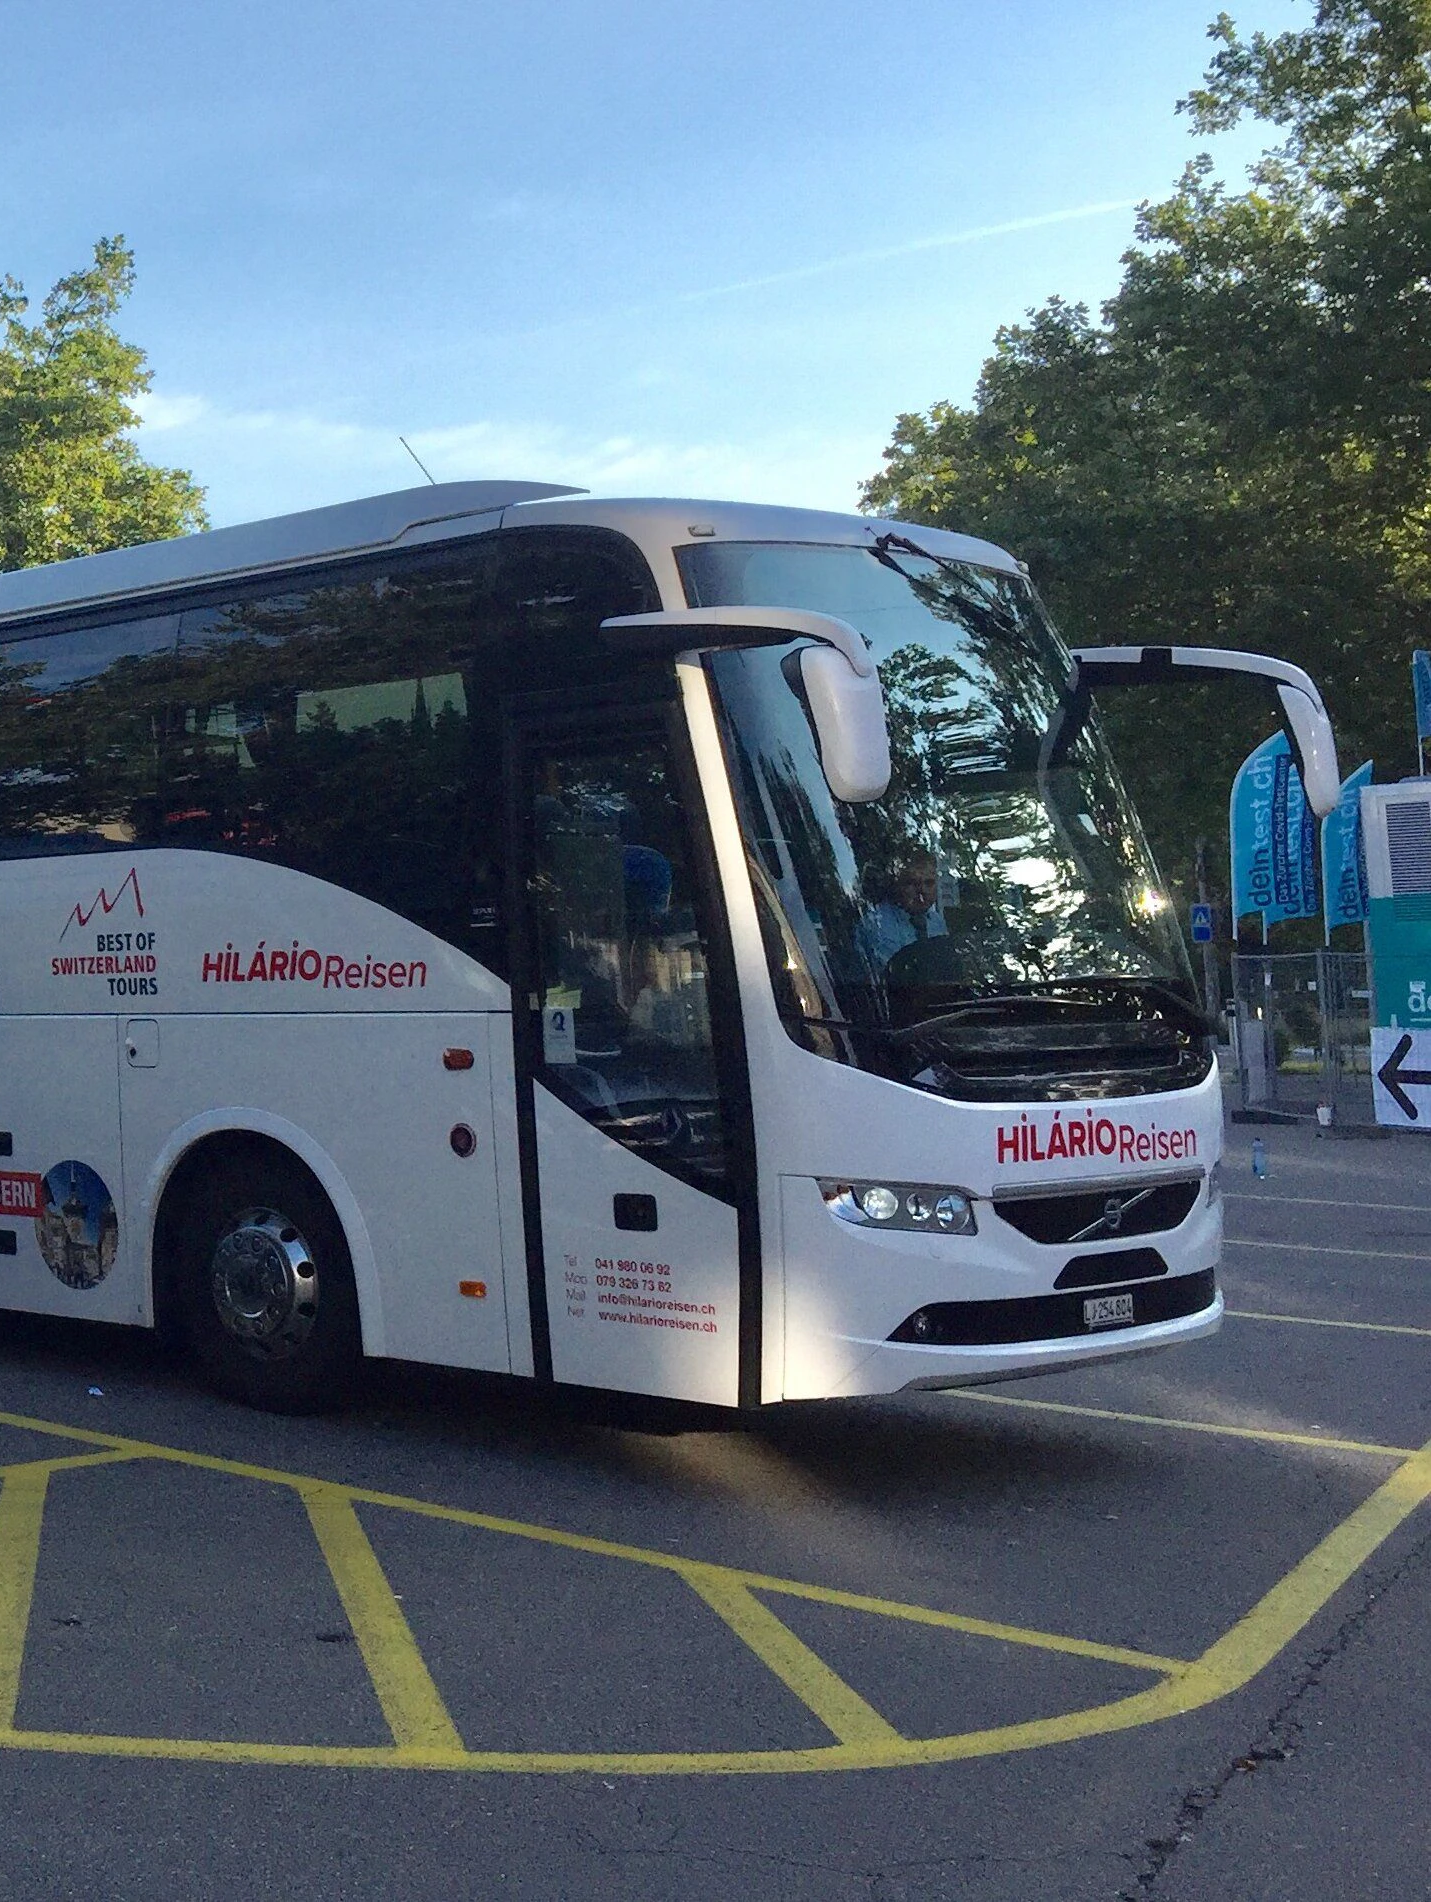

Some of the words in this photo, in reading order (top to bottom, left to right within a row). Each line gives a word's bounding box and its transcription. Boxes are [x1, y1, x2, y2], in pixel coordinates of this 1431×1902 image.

[96, 934, 132, 952] BEST
[135, 932, 156, 951] OF
[51, 954, 157, 975] SWITZERLAND
[322, 954, 427, 989] Reisen
[107, 977, 158, 996] TOURS
[1119, 1122, 1197, 1163] Reisen
[595, 1257, 614, 1270] 041
[640, 1262, 654, 1275] 06
[656, 1263, 671, 1276] 92
[596, 1275, 616, 1288] 079
[641, 1279, 655, 1292] 73
